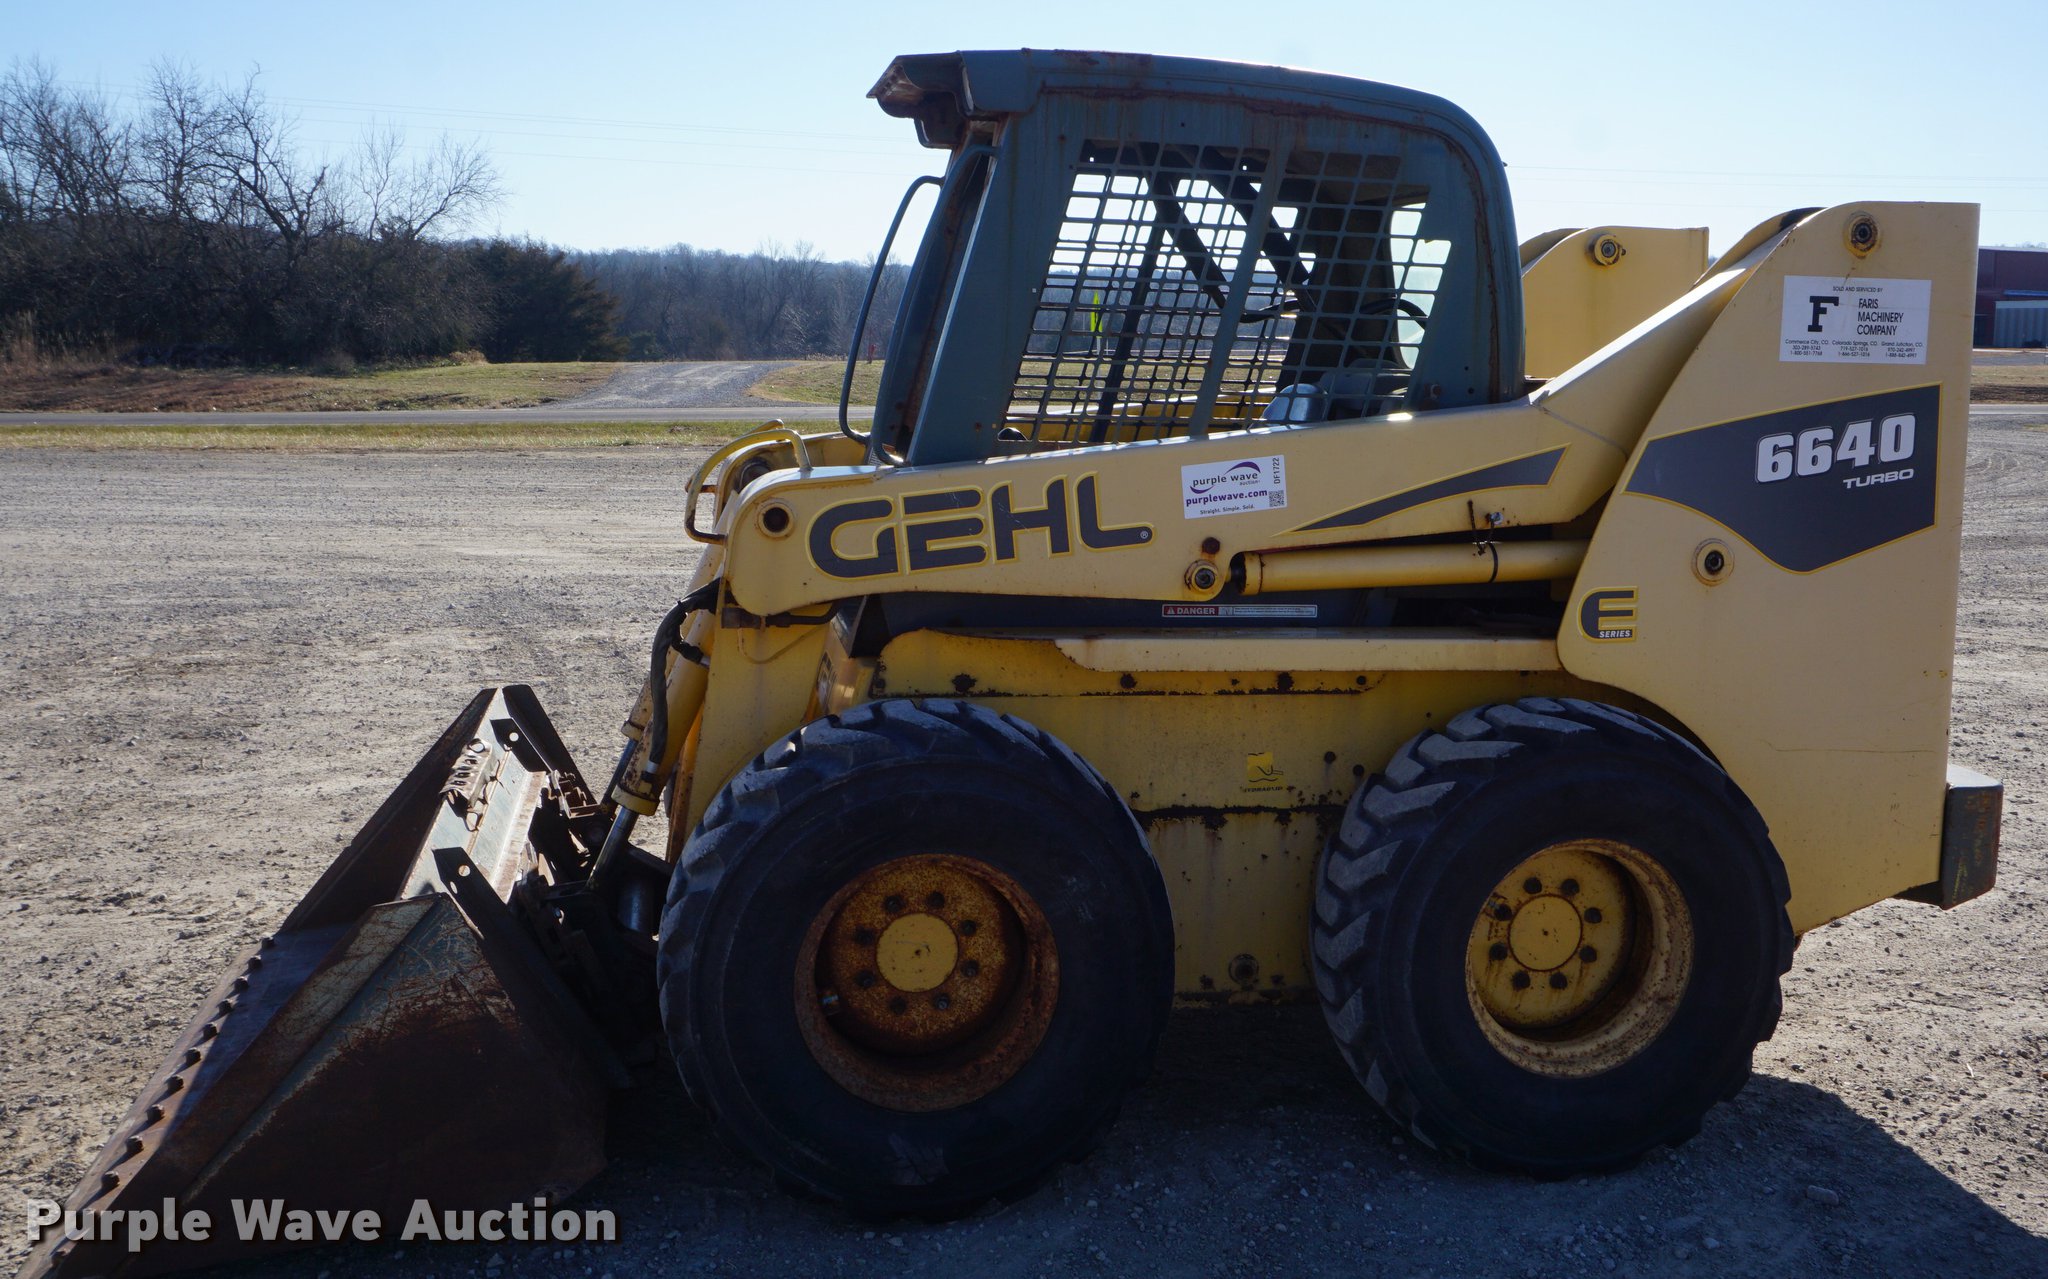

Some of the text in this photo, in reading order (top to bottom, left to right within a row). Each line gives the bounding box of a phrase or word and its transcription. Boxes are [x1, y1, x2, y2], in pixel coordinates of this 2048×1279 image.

[1858, 298, 1879, 309] FARIS
[1807, 295, 1840, 332] F
[1857, 312, 1904, 323] MACHINERY
[1856, 324, 1898, 336] COMPANY
[1755, 413, 1916, 483] 6640
[1192, 472, 1258, 488] purple wave
[1842, 468, 1914, 489] TURBO
[1185, 489, 1268, 507] purplewave.com
[806, 472, 1155, 579] GEHL
[1176, 606, 1216, 615] DANGER
[1580, 589, 1635, 640] E
[1599, 630, 1631, 638] SERIES
